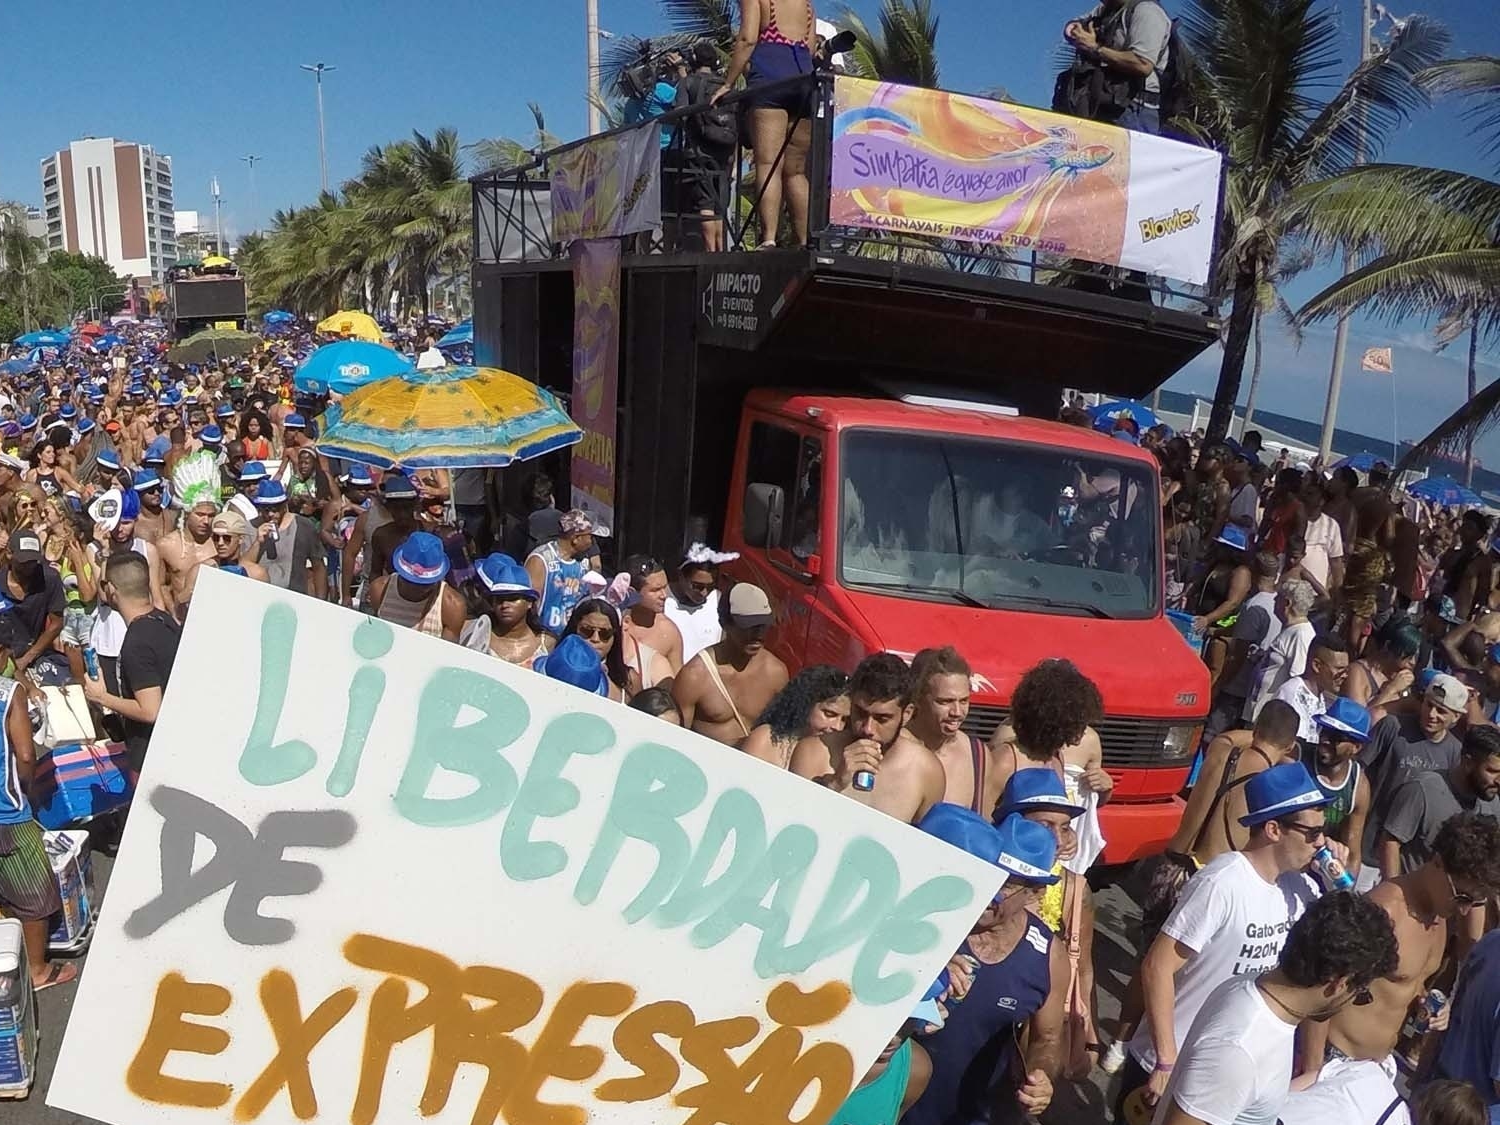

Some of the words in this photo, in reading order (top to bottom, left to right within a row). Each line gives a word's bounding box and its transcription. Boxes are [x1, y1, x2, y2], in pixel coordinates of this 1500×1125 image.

[850, 142, 939, 191] Simpatia
[875, 214, 943, 233] CARNAVAIS
[950, 225, 1003, 242] IPANEMA
[1011, 234, 1031, 247] RIO
[1037, 238, 1067, 253] 2018
[1139, 203, 1202, 243] Blowtex
[716, 272, 761, 294] IMPACTO
[722, 296, 754, 313] EVENTOS
[122, 785, 355, 945] DE
